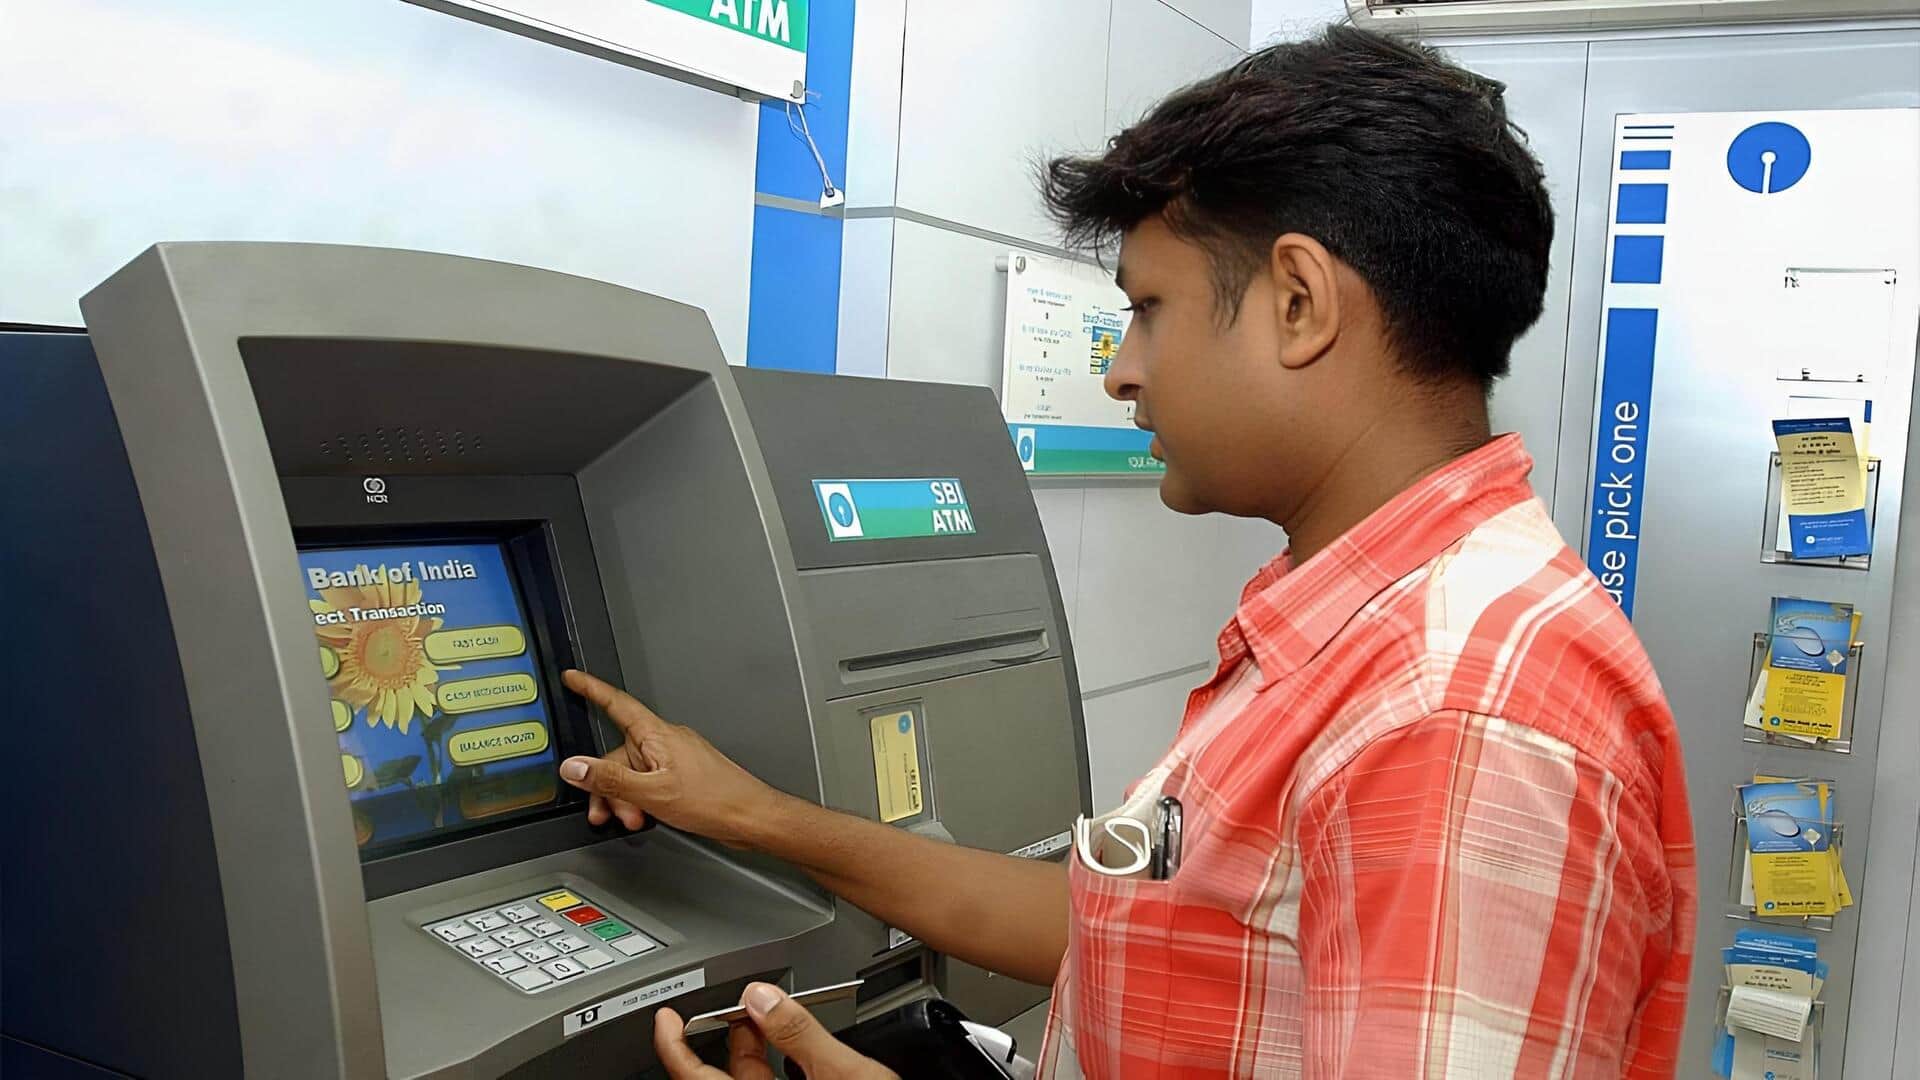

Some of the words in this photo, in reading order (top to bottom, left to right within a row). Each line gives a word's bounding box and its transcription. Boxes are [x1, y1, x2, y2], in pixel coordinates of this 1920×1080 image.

[709, 0, 791, 43] ATM
[1611, 401, 1639, 464] one
[930, 481, 964, 505] SBI
[1598, 472, 1637, 540] pick
[932, 509, 973, 533] ATM
[307, 564, 384, 589] Bank
[388, 561, 412, 583] of
[418, 559, 477, 582] India
[349, 602, 446, 622] Transaction
